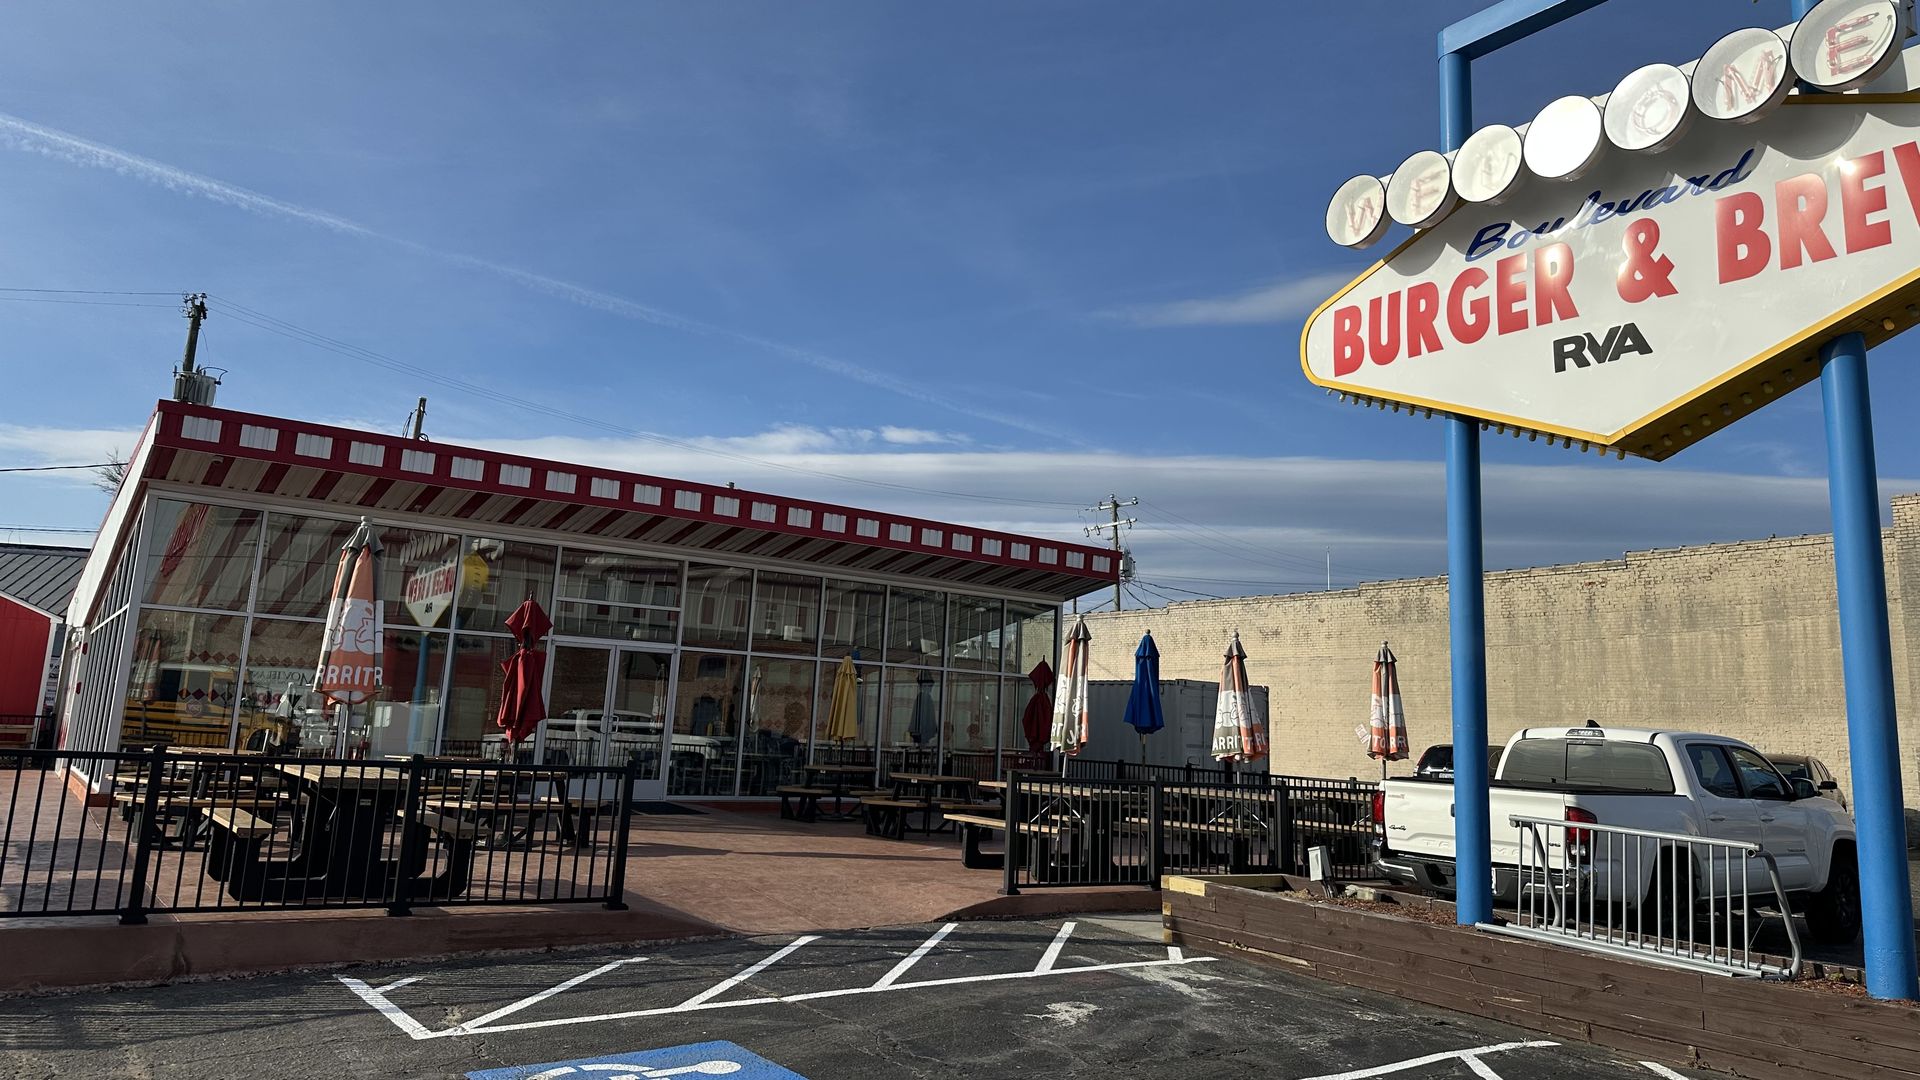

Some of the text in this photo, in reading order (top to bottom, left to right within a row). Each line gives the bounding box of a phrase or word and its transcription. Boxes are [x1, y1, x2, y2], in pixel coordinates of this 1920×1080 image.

[1342, 9, 1890, 238] WELOME
[1465, 148, 1754, 262] Boulevard
[1333, 241, 1580, 378] BURGER
[1616, 217, 1679, 304] &
[1552, 321, 1654, 374] RVA
